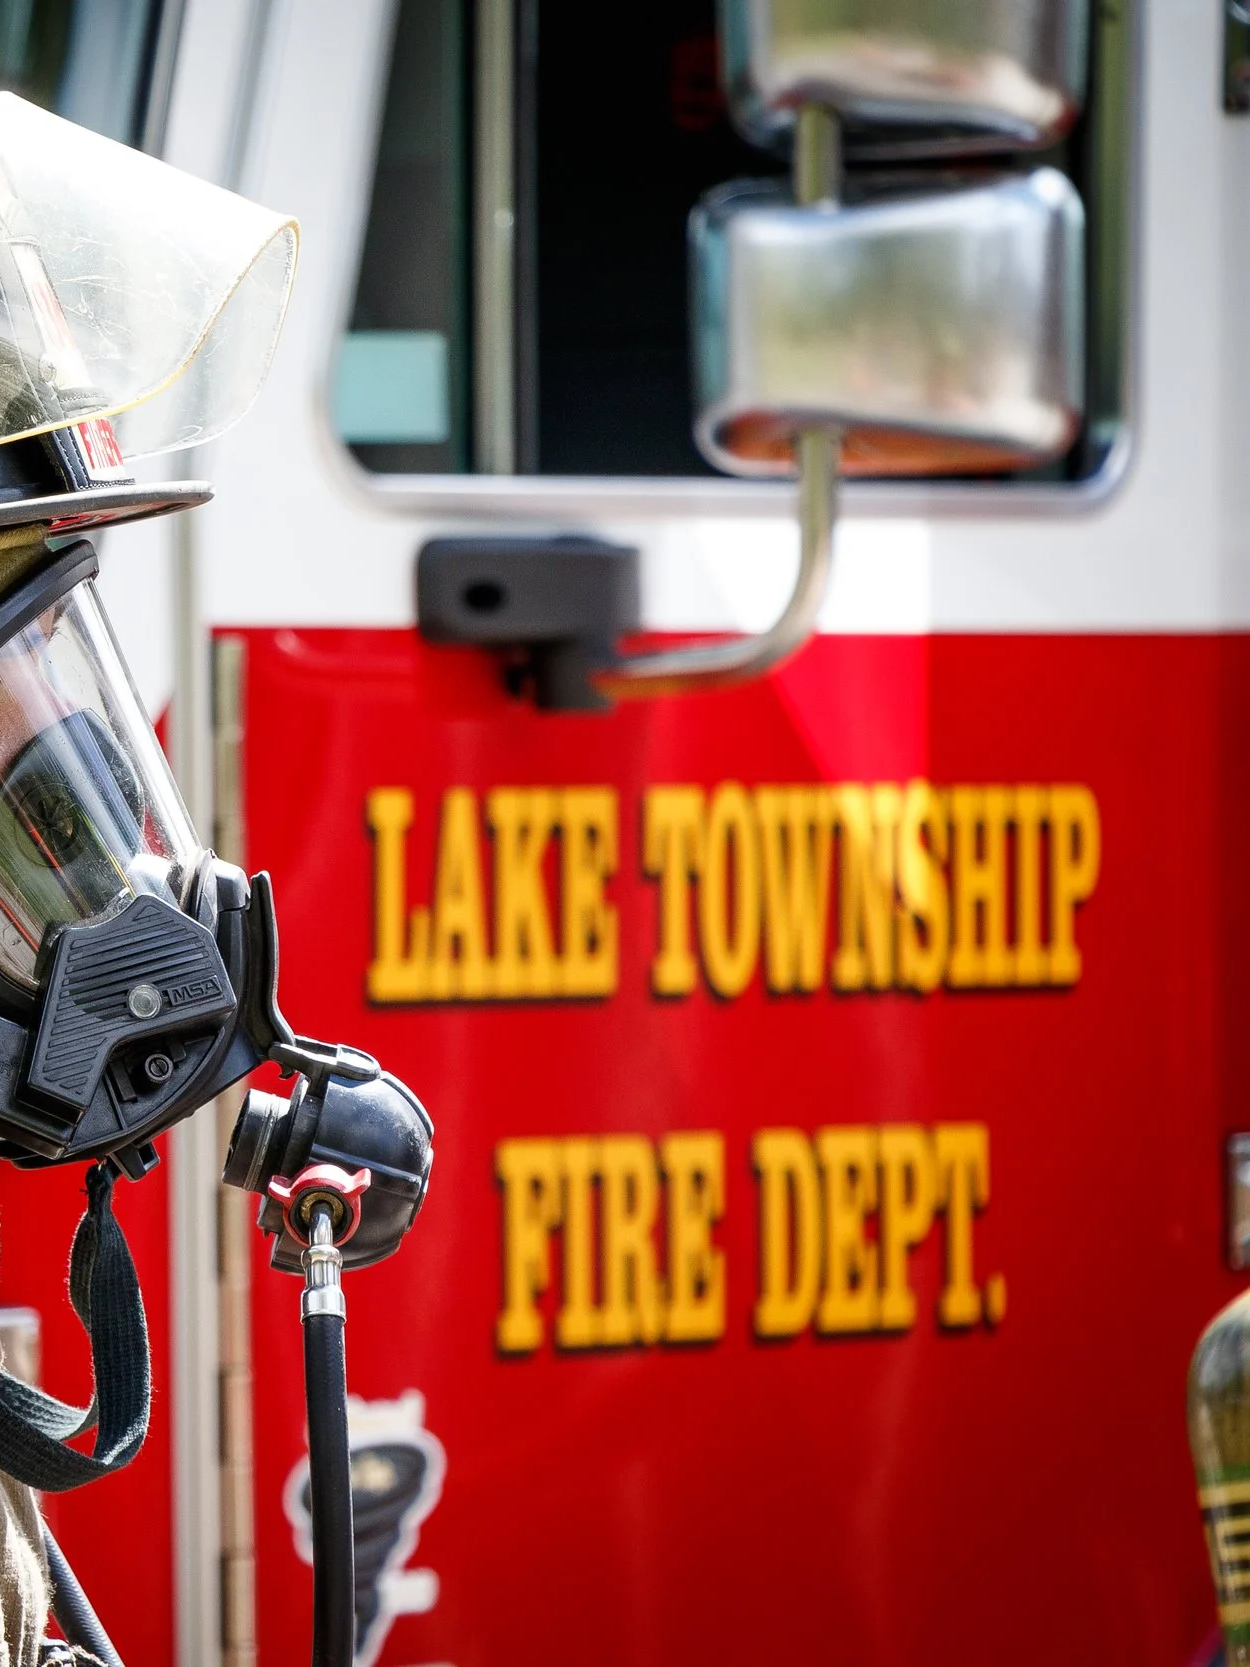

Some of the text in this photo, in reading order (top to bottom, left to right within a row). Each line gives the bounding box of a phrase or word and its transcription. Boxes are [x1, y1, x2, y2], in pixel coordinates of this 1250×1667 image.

[172, 979, 221, 1003] MSA
[364, 779, 1102, 1003] LAKE TOWNSHIP
[495, 1121, 1009, 1353] FIRE DEPT.
